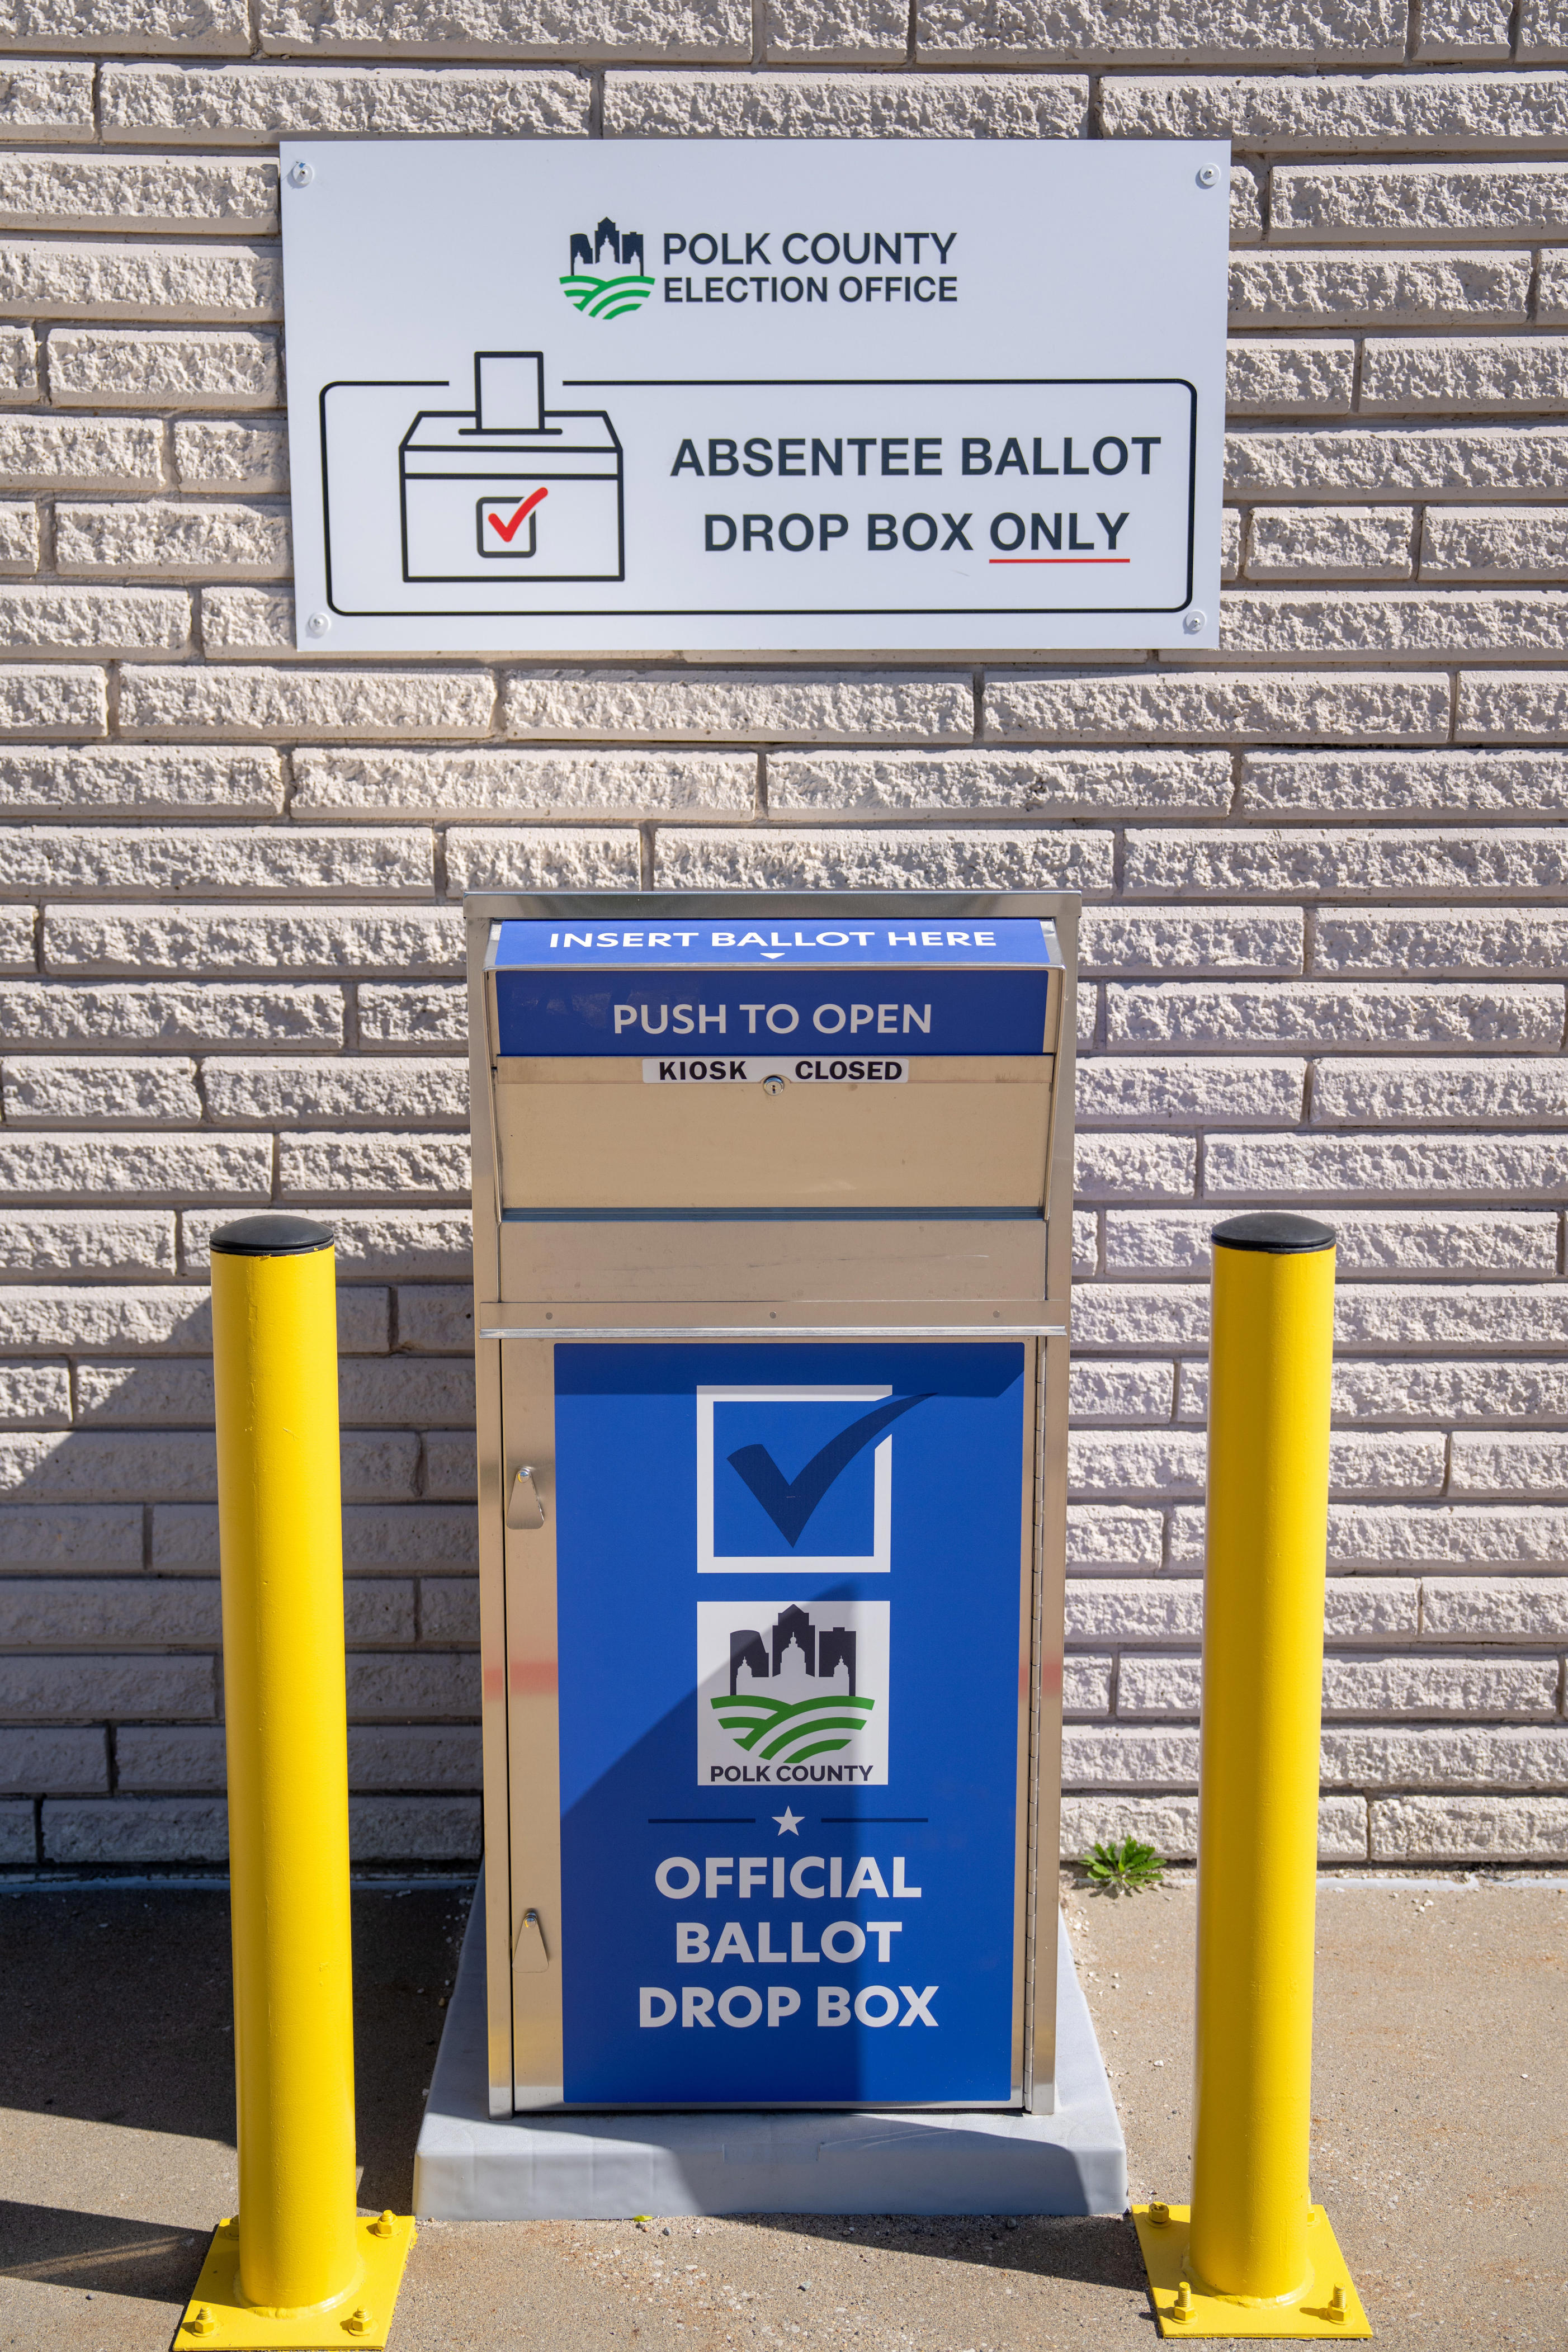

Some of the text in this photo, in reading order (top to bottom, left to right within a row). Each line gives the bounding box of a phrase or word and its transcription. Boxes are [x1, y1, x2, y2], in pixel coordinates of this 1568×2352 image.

[664, 232, 957, 265] POLK COUNTY
[664, 276, 957, 303] ELECTION OFFICE
[670, 436, 1161, 477] ABSENTEE BALLOT
[705, 512, 1130, 552] DROP BOX ONLY
[550, 932, 996, 948] INSERT BALLOT HERE
[613, 1003, 932, 1035] PUSH TO OPEN
[659, 1060, 902, 1080] KIOSK CLOSED
[711, 1765, 873, 1782] POLK COUNTY
[655, 1856, 922, 1900] OFFICIAL
[676, 1921, 903, 1963] BALLOT
[639, 1985, 939, 2028] DROP BOX
